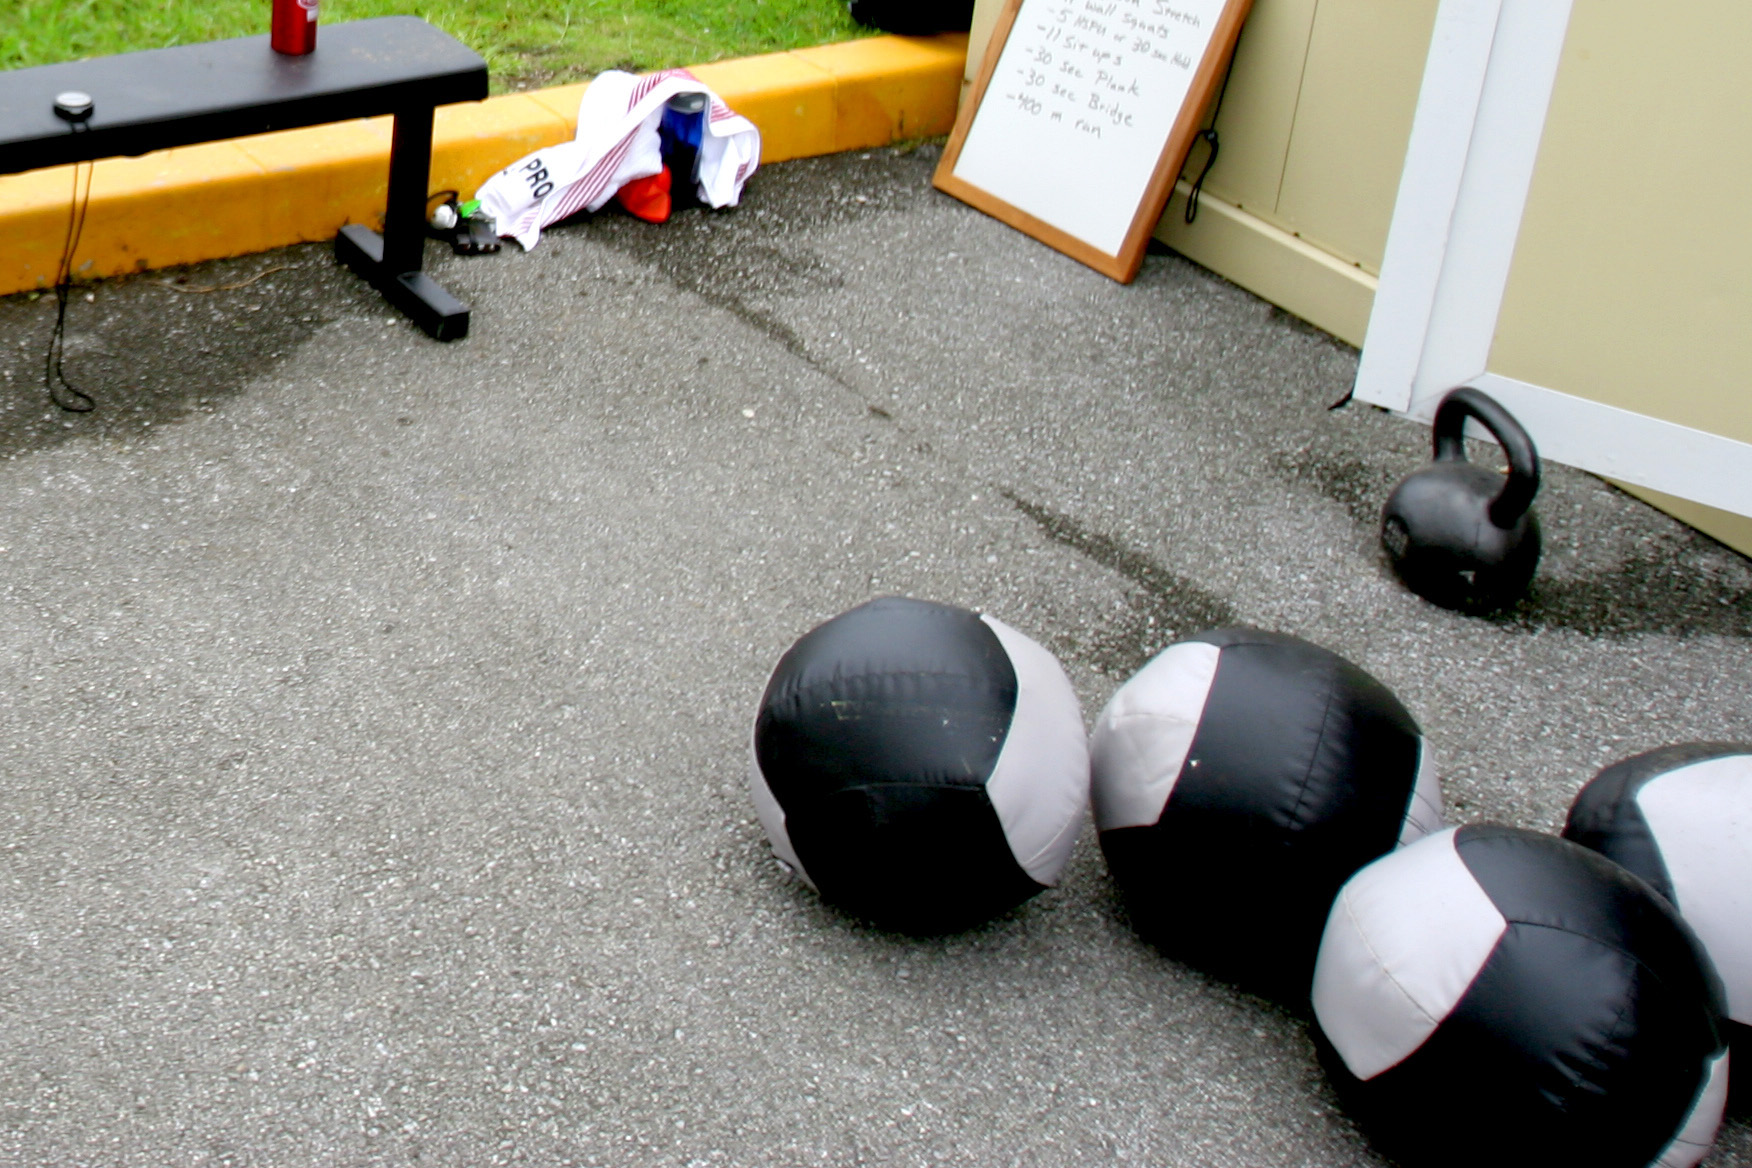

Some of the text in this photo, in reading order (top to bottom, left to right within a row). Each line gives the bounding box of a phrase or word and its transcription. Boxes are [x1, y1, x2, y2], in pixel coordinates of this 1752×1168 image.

[1132, 37, 1151, 53] 30
[1095, 69, 1140, 97] Plank
[1088, 93, 1133, 127] Bridge
[519, 157, 554, 199] PRO
